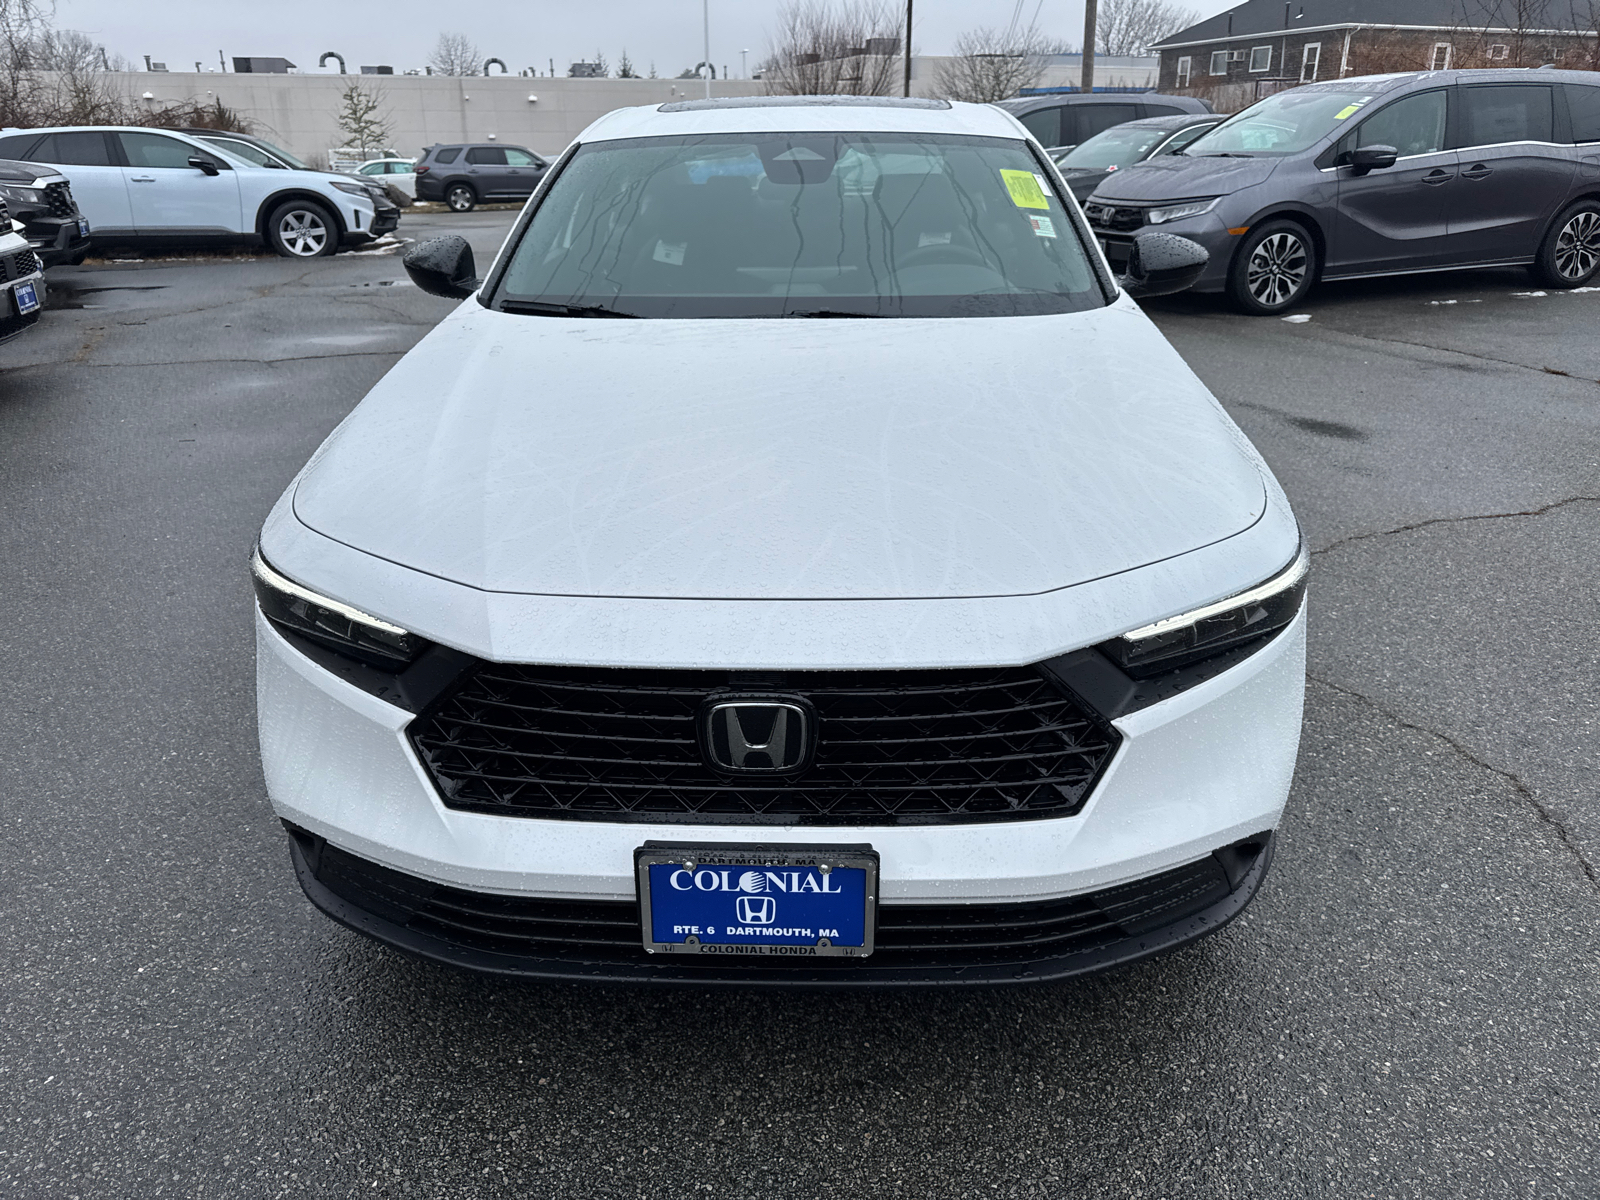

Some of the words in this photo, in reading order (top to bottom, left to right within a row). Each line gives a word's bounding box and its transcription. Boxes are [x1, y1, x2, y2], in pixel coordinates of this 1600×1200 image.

[795, 858, 816, 866] MA
[669, 869, 842, 894] COLONIAL
[673, 925, 704, 935] RTE.
[706, 926, 716, 936] 6
[726, 926, 815, 938] DARTMOUTH,
[818, 928, 840, 938] MA
[700, 945, 766, 955] COLONIAL
[769, 946, 817, 955] HONDA
